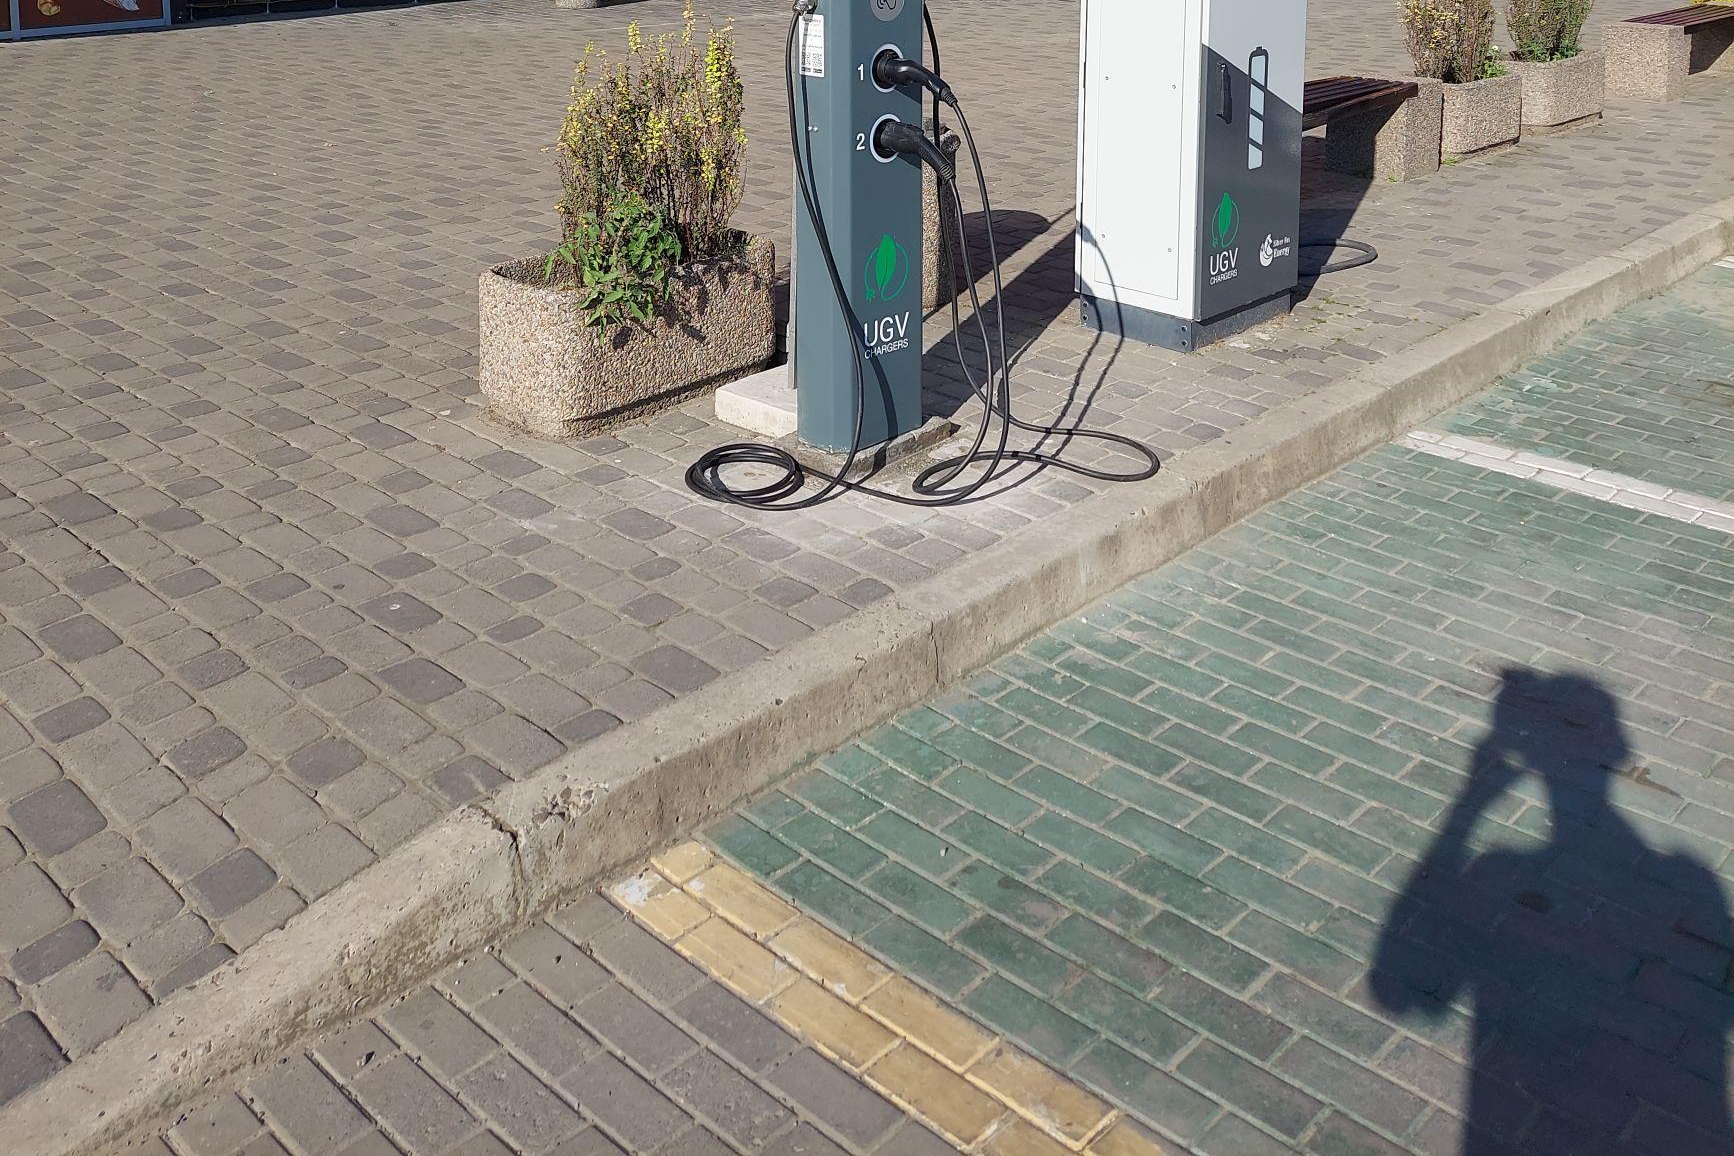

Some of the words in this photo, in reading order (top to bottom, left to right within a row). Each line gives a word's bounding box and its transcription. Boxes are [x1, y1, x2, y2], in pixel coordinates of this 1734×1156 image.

[857, 63, 864, 81] 1
[856, 133, 865, 151] 2
[1210, 247, 1239, 275] UGV
[1209, 269, 1238, 285] CHARGERS
[864, 311, 910, 347] UGV
[864, 338, 909, 359] CHARGERS
